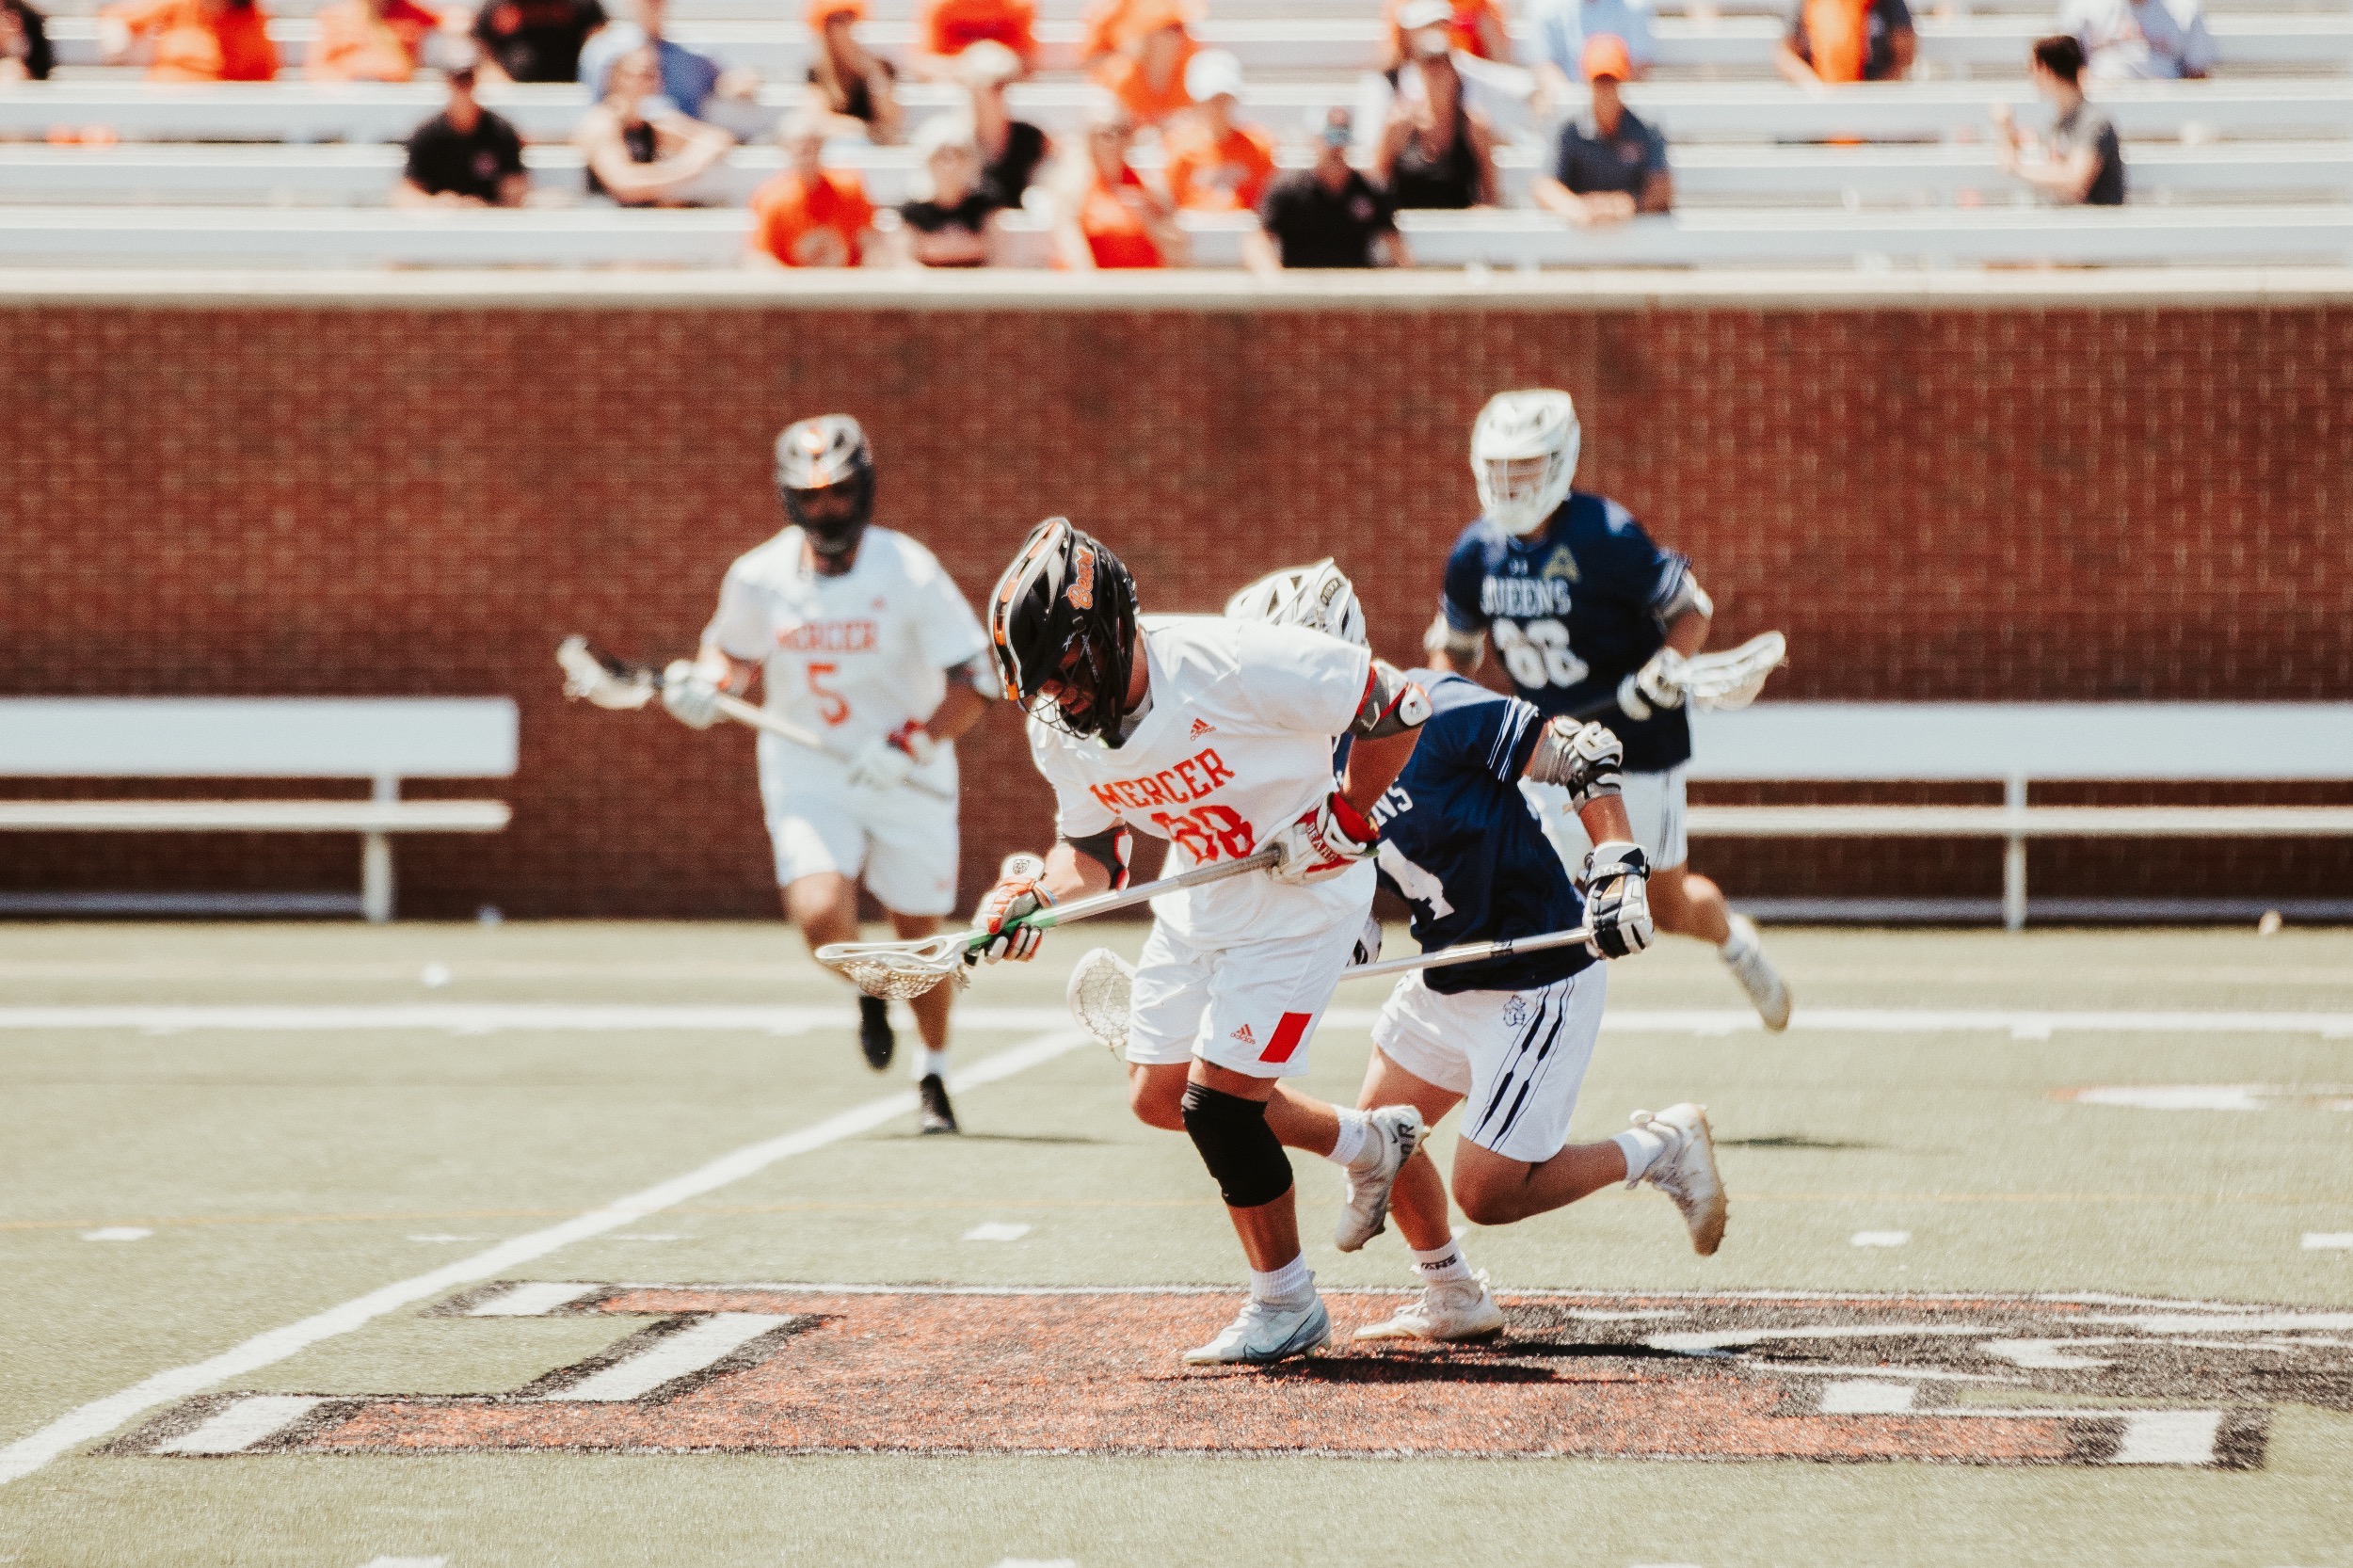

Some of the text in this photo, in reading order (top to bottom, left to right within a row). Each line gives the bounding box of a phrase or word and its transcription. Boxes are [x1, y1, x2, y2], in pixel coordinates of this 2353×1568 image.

[806, 662, 850, 726] 5
[1089, 747, 1235, 815] MERCER
[1229, 1032, 1257, 1046] adidas
